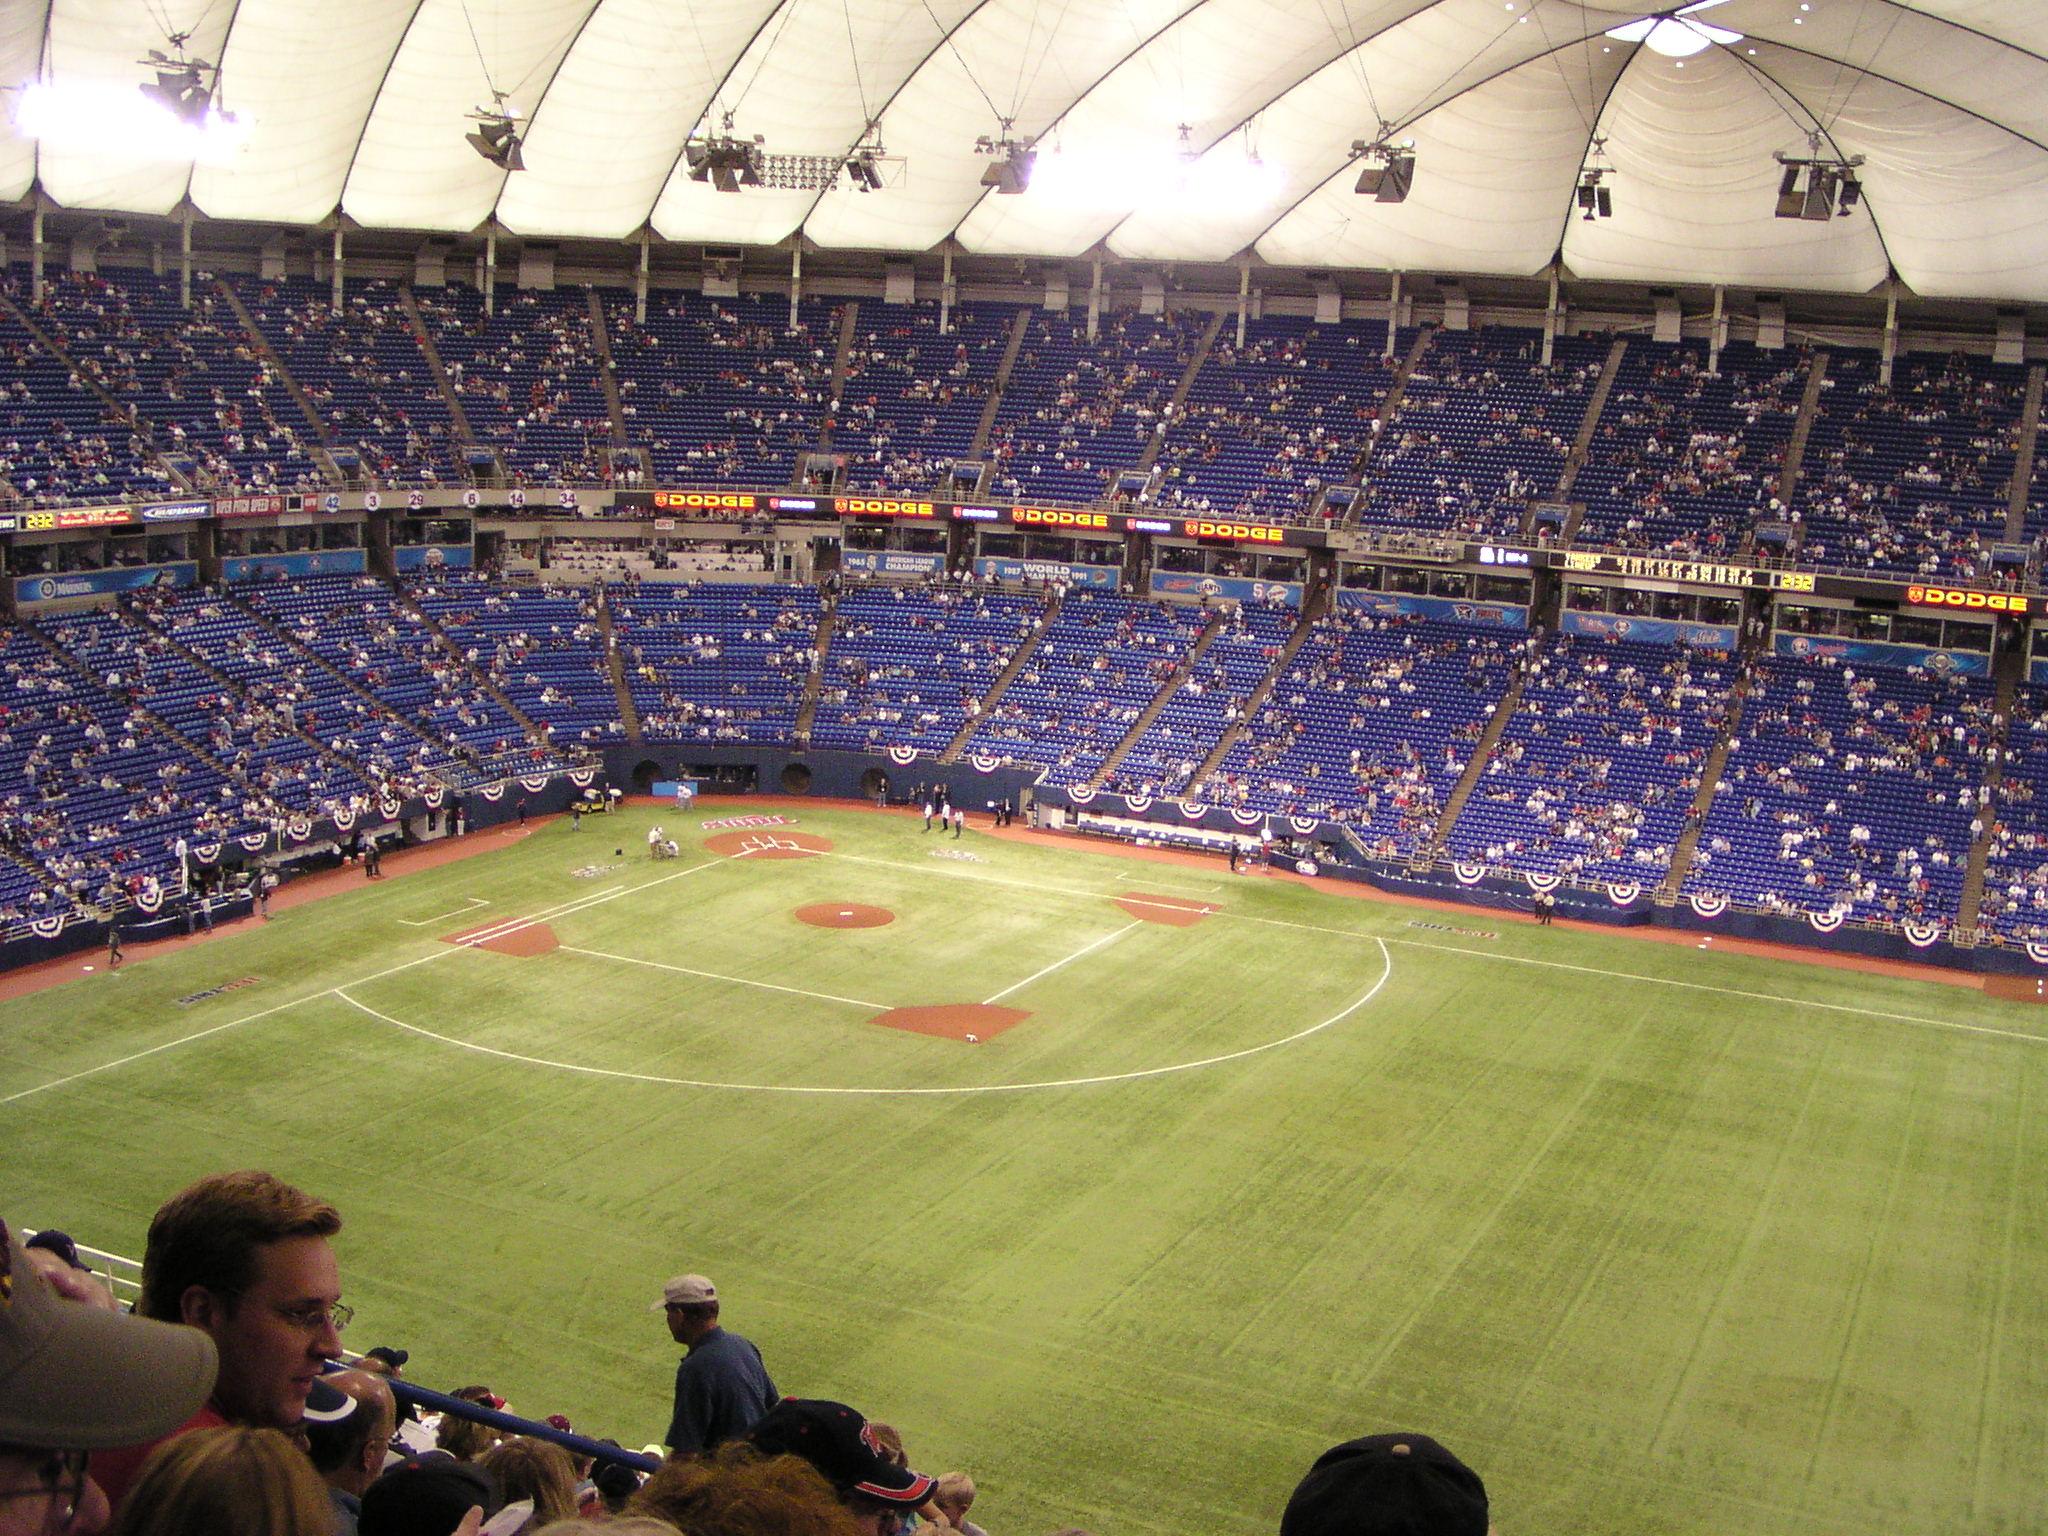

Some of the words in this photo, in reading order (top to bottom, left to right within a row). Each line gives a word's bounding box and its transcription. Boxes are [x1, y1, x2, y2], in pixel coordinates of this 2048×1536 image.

[410, 494, 424, 505] 29
[510, 493, 523, 504] 14
[560, 493, 575, 504] 34
[668, 494, 755, 508] DODGE
[849, 500, 934, 515] DODGE
[27, 512, 54, 529] 2:32
[1026, 510, 1108, 527] DODGE
[1200, 523, 1284, 542] DODGE
[1023, 564, 1070, 575] WORLD
[1782, 573, 1813, 591] 2:32
[1925, 588, 2027, 611] DODGE
